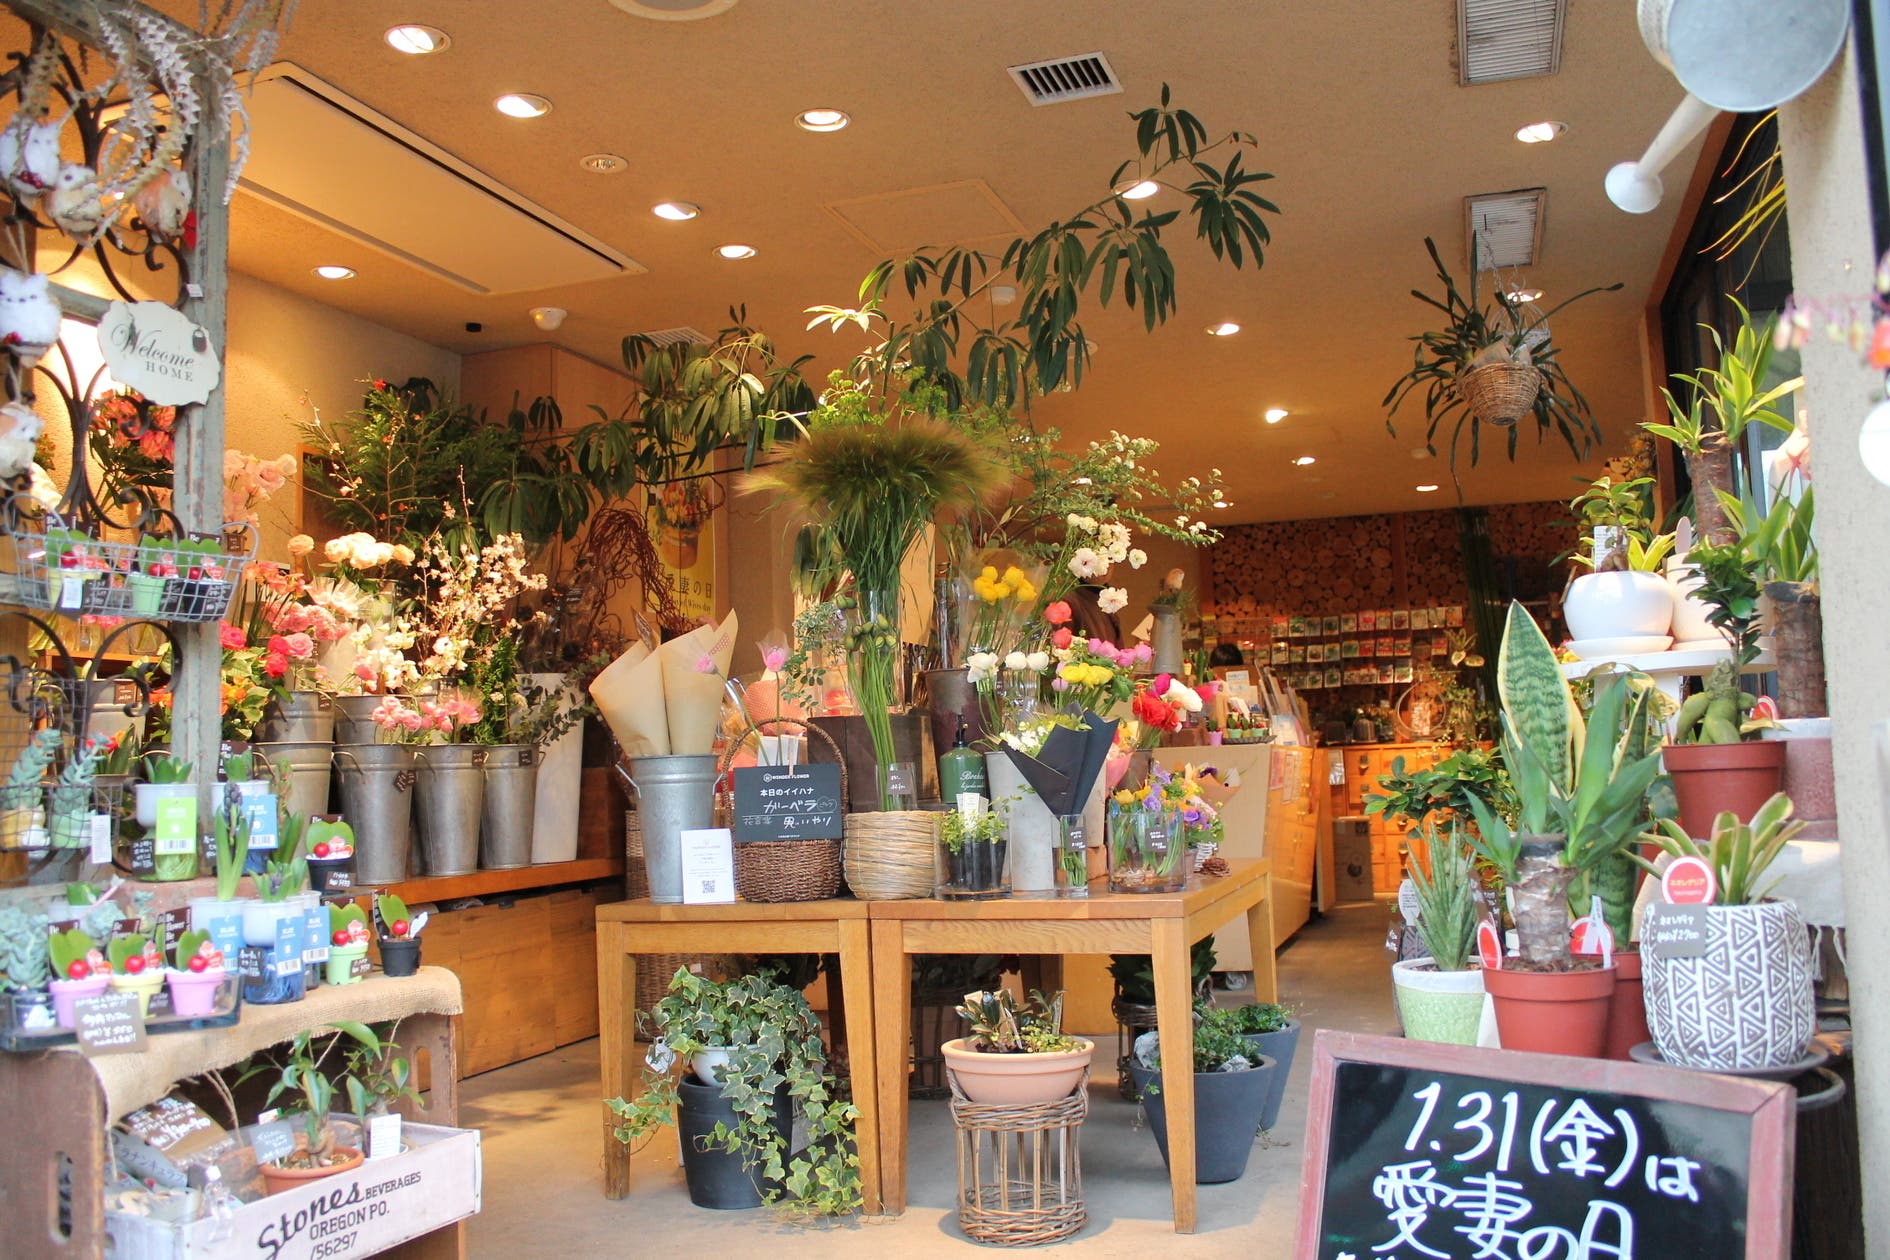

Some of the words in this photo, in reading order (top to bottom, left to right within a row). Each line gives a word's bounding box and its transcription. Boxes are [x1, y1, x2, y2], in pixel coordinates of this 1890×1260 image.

[111, 323, 195, 368] Welcome
[144, 361, 194, 382] HOME
[760, 787, 814, 797] 本日のイイハナ
[763, 799, 818, 814] ガーベラ
[257, 1181, 365, 1260] Stones
[365, 1171, 422, 1201] BEVERAGES
[309, 1207, 366, 1241] OREGON
